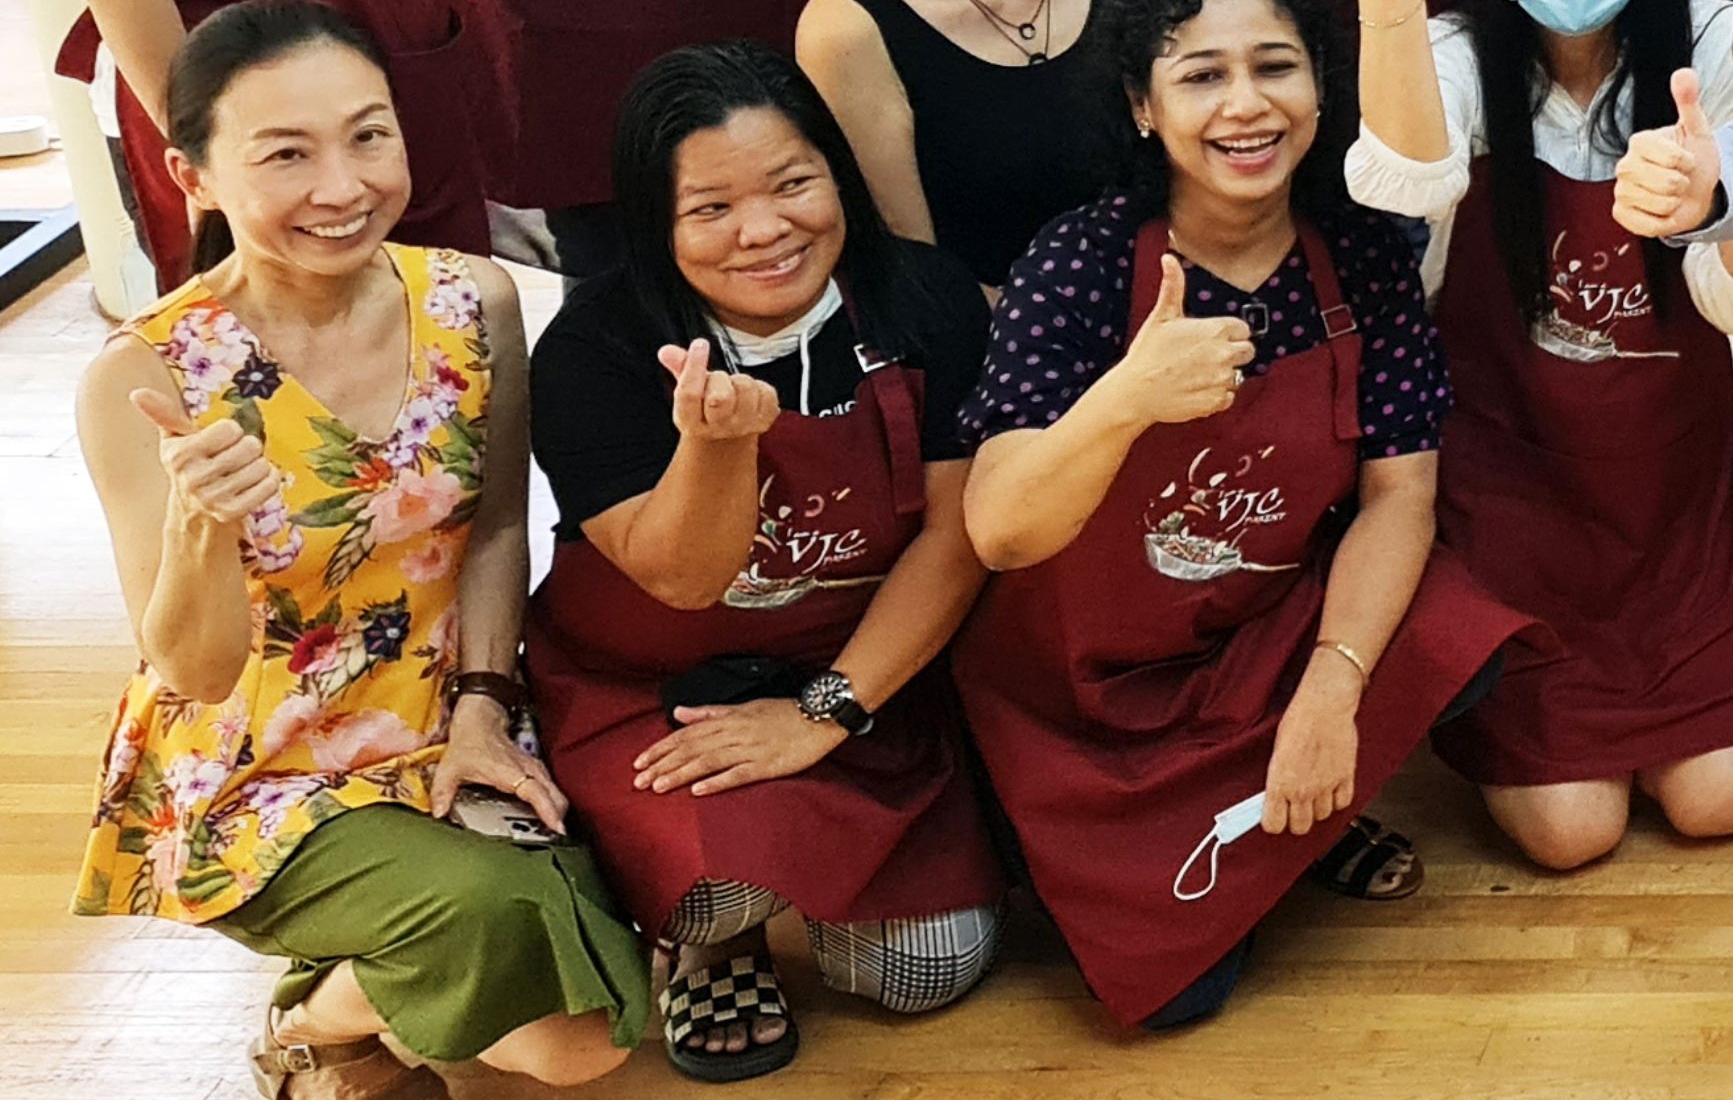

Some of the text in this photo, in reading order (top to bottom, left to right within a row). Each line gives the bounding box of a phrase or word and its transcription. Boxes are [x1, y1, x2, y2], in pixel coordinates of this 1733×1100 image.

[1578, 283, 1648, 324] VJC
[1217, 487, 1284, 532] VJC
[786, 529, 867, 574] VJC
